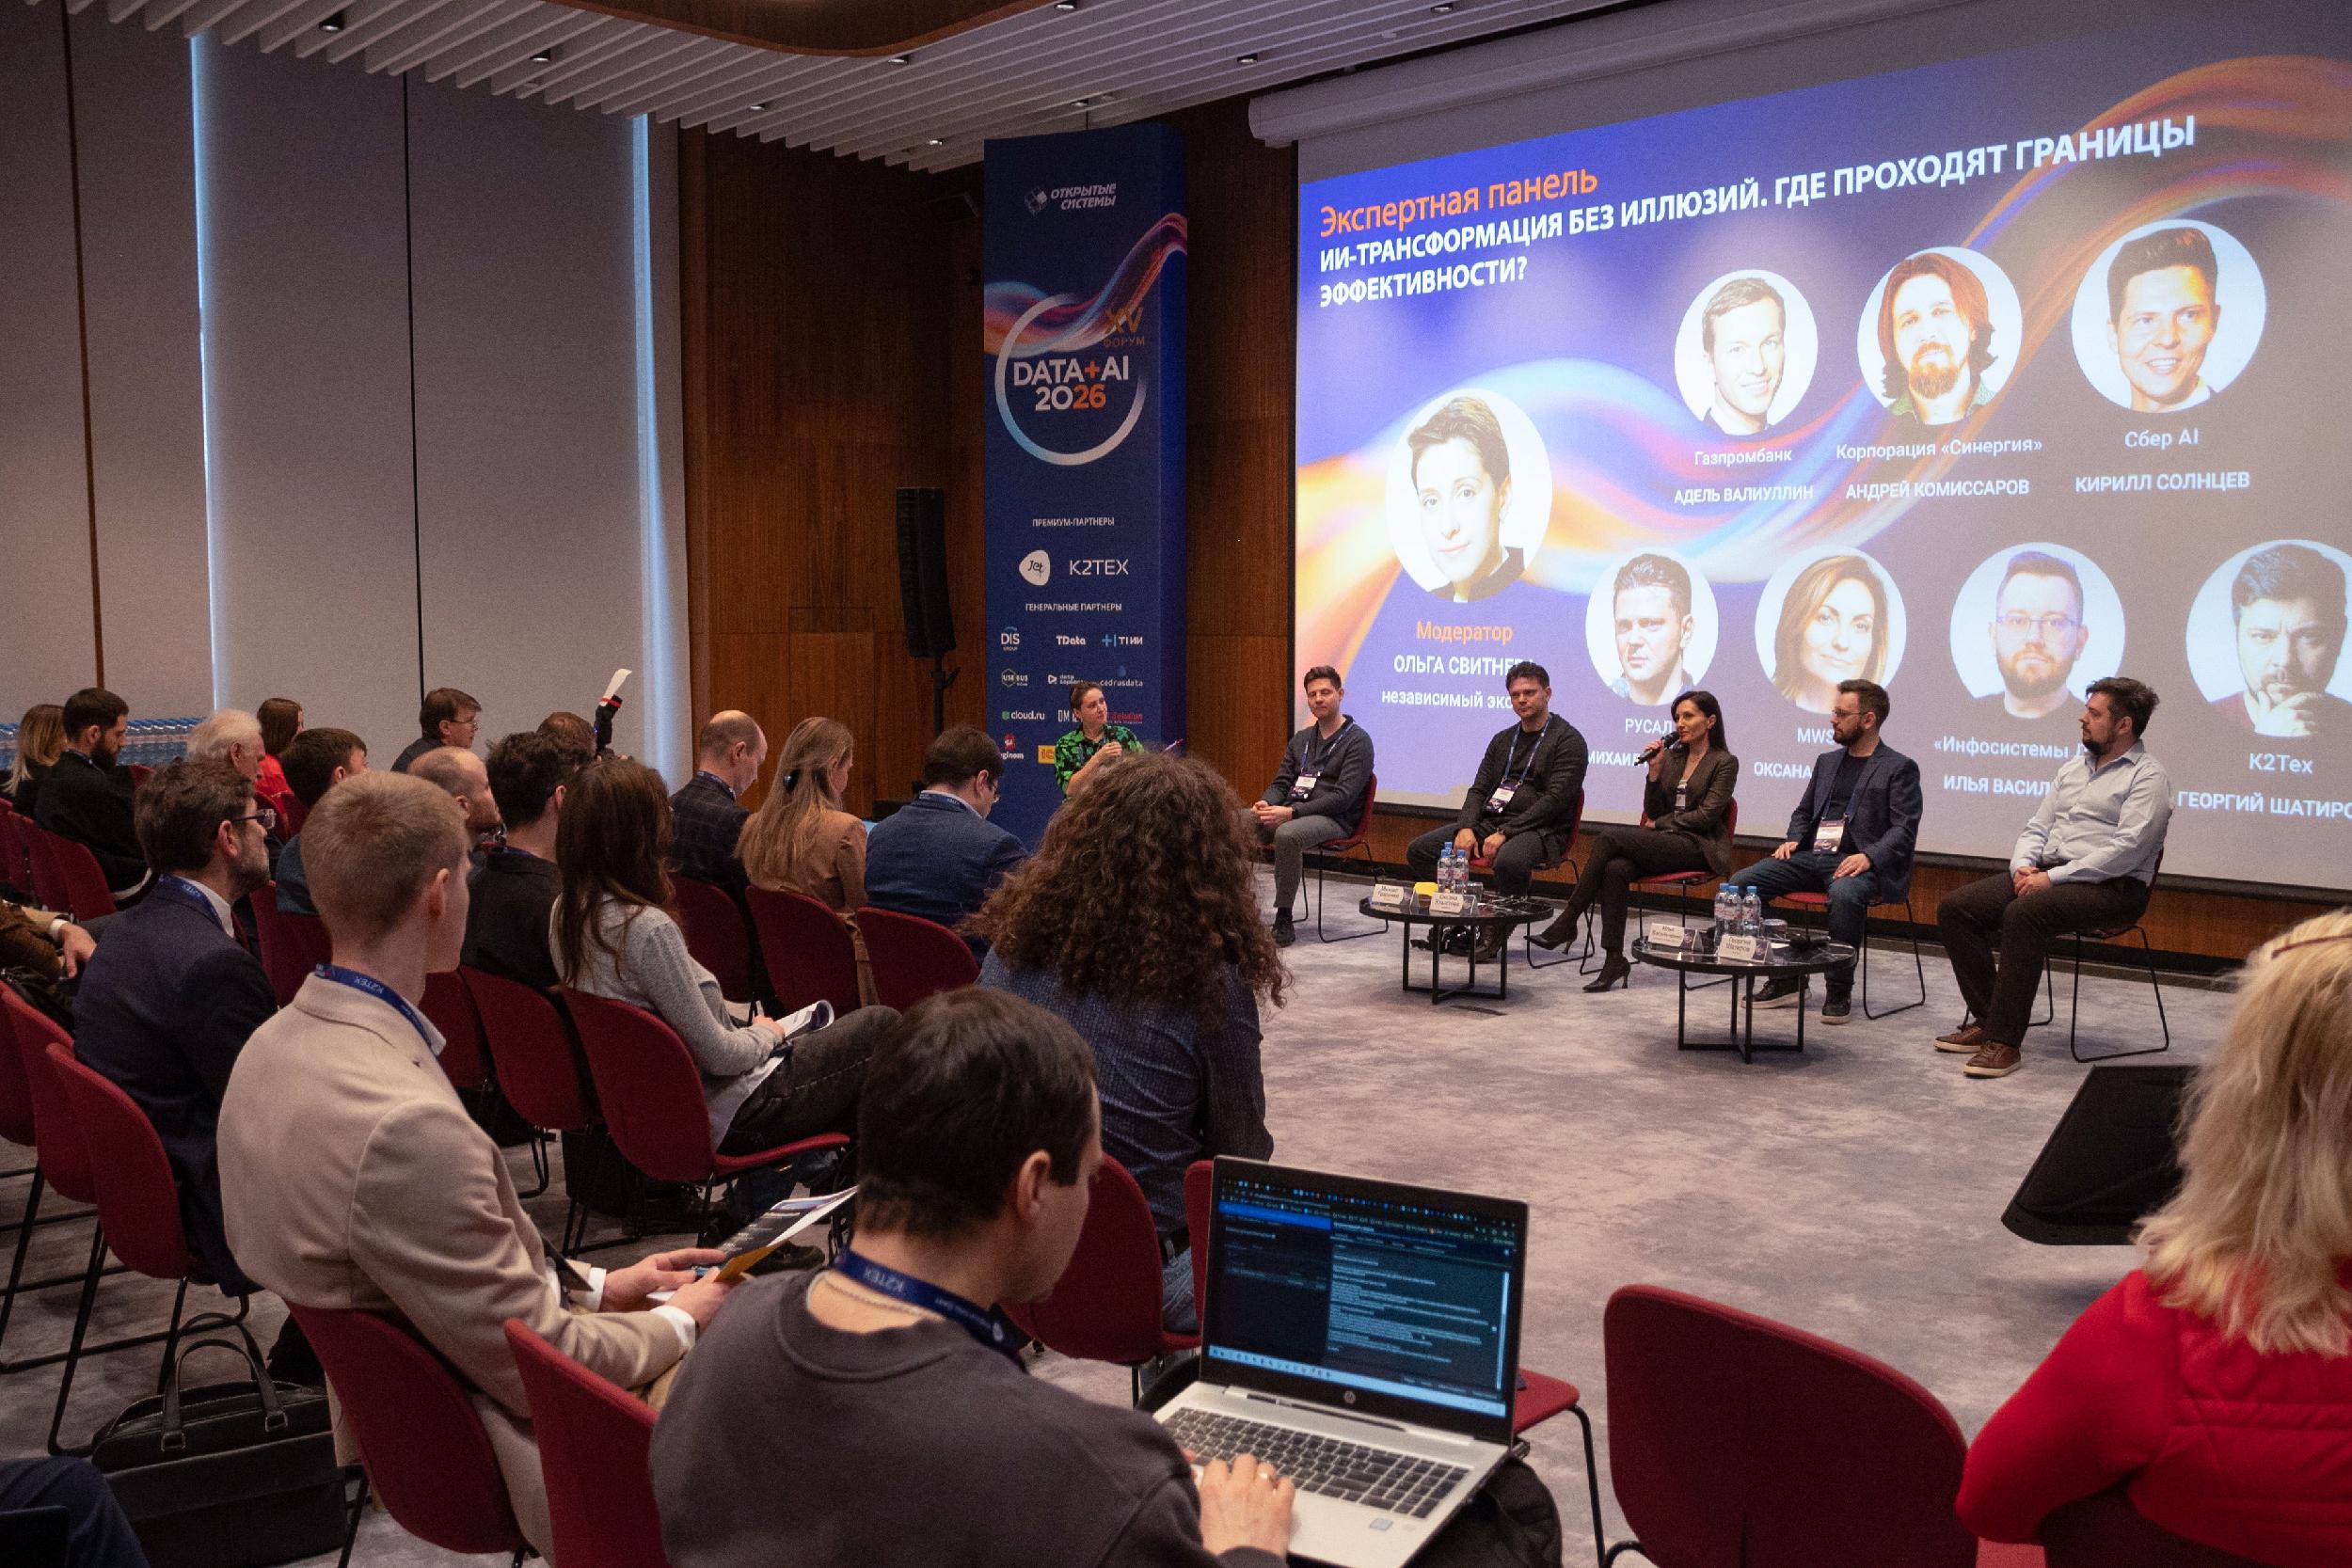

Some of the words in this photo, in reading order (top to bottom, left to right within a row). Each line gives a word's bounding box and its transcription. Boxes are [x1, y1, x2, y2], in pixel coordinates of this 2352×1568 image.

[1051, 183, 1116, 199] ОТКРЫТЫЕ
[1320, 213, 1563, 273] ИИ-ТРАНСФОРМАЦИЯ
[1569, 206, 1613, 235] БЕЗ
[1621, 177, 1767, 229] ИЛЛЮЗИЙ.
[1774, 171, 1826, 208] ГДЕ
[1834, 144, 2007, 197] ПРОХОДЯТ
[2016, 115, 2195, 170] ГРАНИЦЫ
[1060, 195, 1116, 211] СИСТЕМЫ
[1320, 186, 1479, 238] Экспертная
[1488, 168, 1597, 209] панель
[1320, 256, 1528, 308] ЭФФЕКТИВНОСТИ?
[1103, 336, 1145, 348] ФОРУМ
[1013, 356, 1129, 386] DATA+AI
[1035, 384, 1106, 411] 2026
[2124, 429, 2172, 451] Сбер
[2178, 428, 2199, 445] AI
[1694, 448, 1792, 467] Газпромбанк
[1836, 442, 1936, 463] Корпорация
[1941, 438, 2042, 458] «Синергия»
[1846, 480, 1910, 501] АНДРЕЙ
[1914, 479, 2030, 499] КОМИССАРОВ
[2075, 473, 2152, 493] КИРИЛЛ
[2156, 471, 2250, 491] СОЛНЦЕВ
[1674, 486, 1721, 506] АДЕЛЬ
[1724, 484, 1814, 502] ВАЛИУЛЛИН
[1032, 517, 1115, 528] ПРЕМИУМ-ПАРТНЕРЫ
[1025, 603, 1079, 612] ГЕНЕРАЛЬНЫЕ
[1080, 602, 1122, 611] ПАРТНЕРЫ
[1000, 633, 1020, 645] DIS
[1056, 635, 1086, 646] TData
[1416, 620, 1514, 645] Модератор
[1393, 655, 1444, 674] ОЛЬГА
[1100, 678, 1144, 687] cedrusdata
[1382, 689, 1483, 708] независимый
[1010, 710, 1045, 721] cloud.ru
[1625, 718, 1673, 735] РУСАЛ
[1934, 736, 2069, 759] «Инфосистемы
[1754, 761, 1812, 779] ОКСАНА
[1943, 774, 1989, 794] ИЛЬЯ
[2177, 790, 2264, 813] ГЕОРГИЙ
